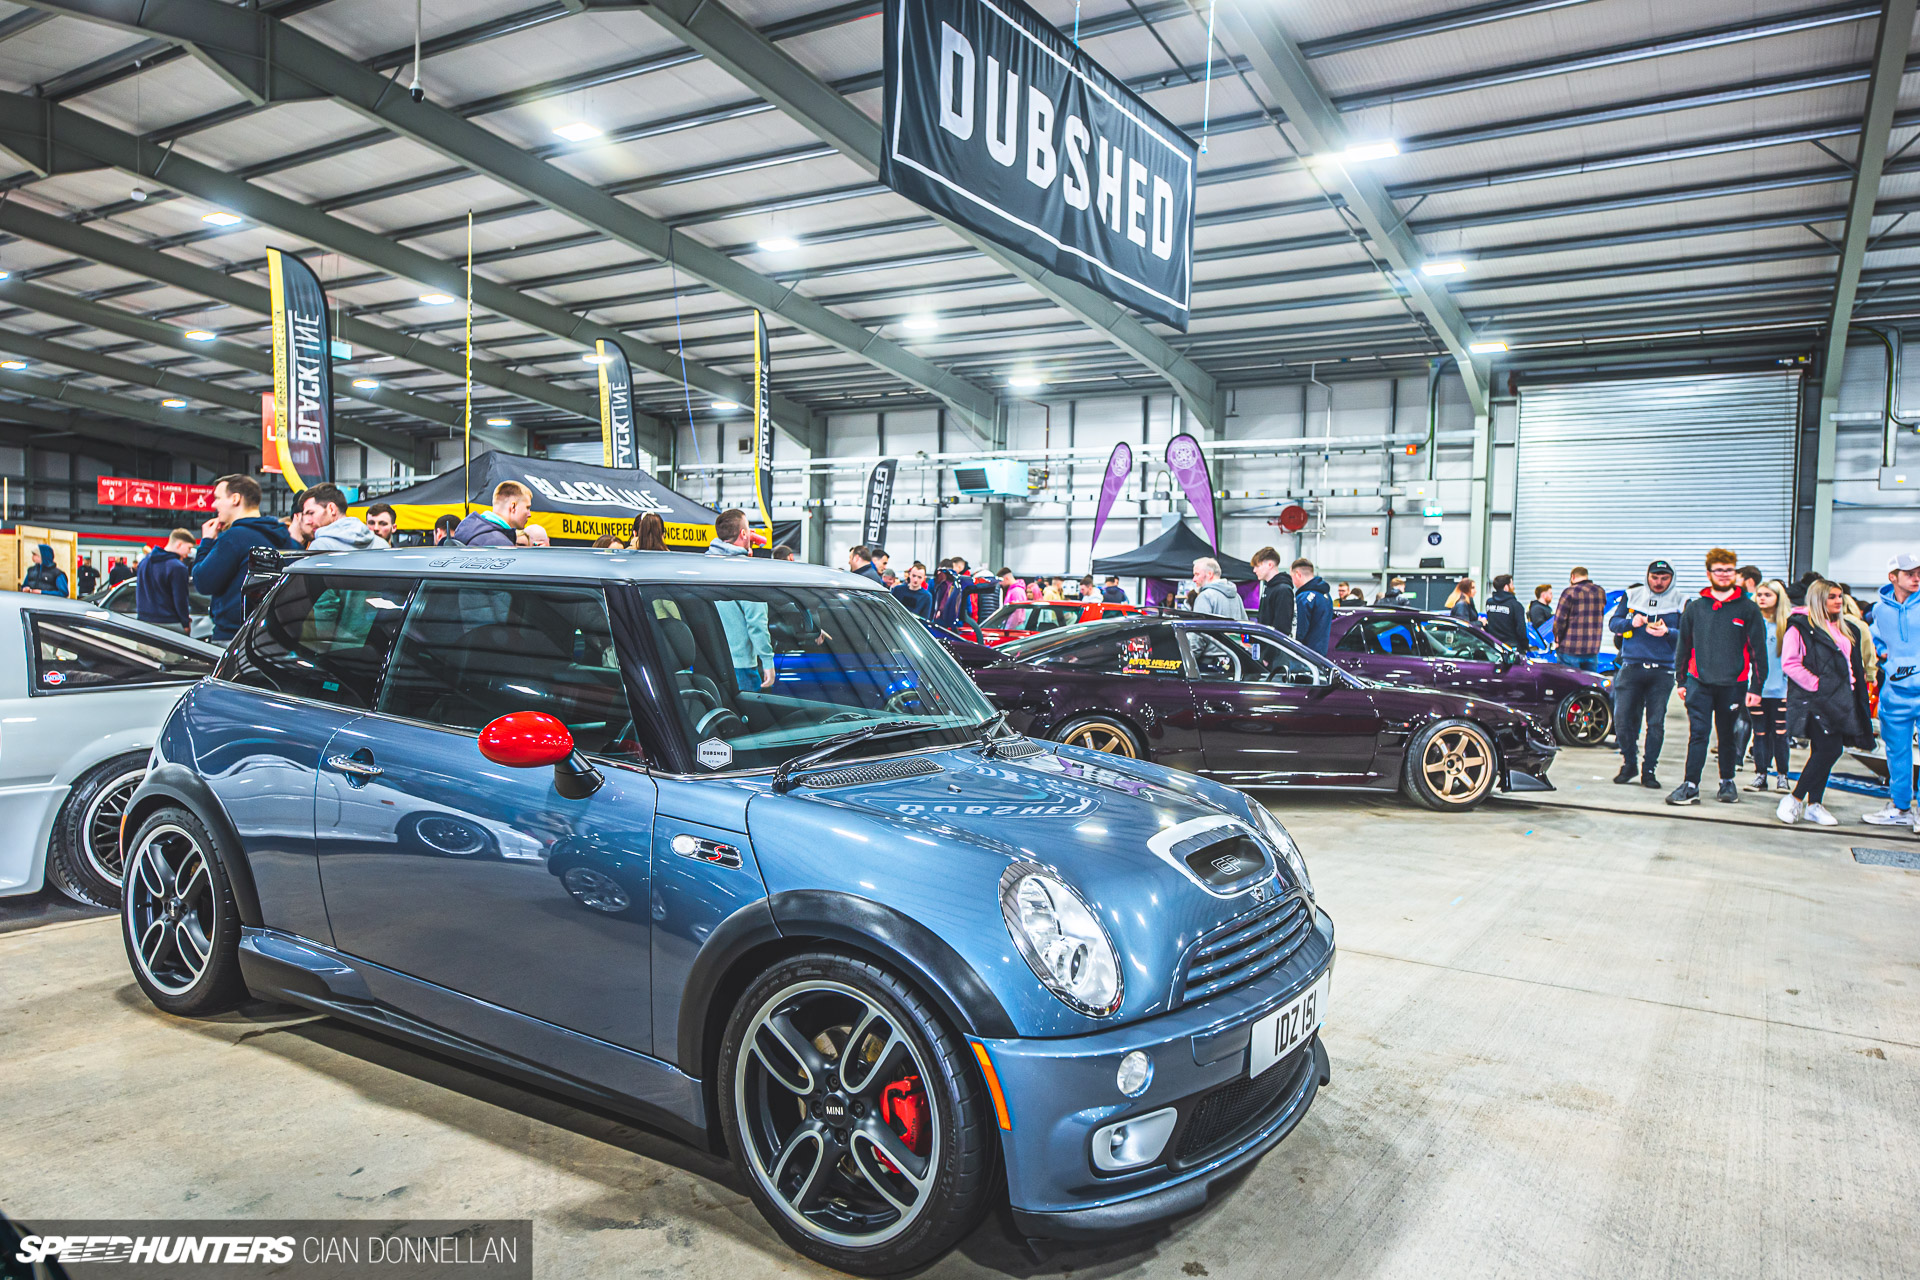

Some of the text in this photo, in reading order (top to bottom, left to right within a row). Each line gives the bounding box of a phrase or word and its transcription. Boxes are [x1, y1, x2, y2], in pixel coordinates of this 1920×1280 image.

[939, 21, 1174, 261] DUBSHED
[524, 474, 669, 509] BLACKLINE
[867, 467, 889, 541] BISPER
[562, 518, 707, 542] BLACKLINEPERNCE.CO.UK
[1897, 665, 1917, 675] NIKE
[707, 845, 728, 861] S
[1210, 854, 1241, 876] GP
[1275, 989, 1317, 1056] IDZ 151
[825, 1105, 844, 1116] MINI
[909, 1117, 917, 1145] WORKS
